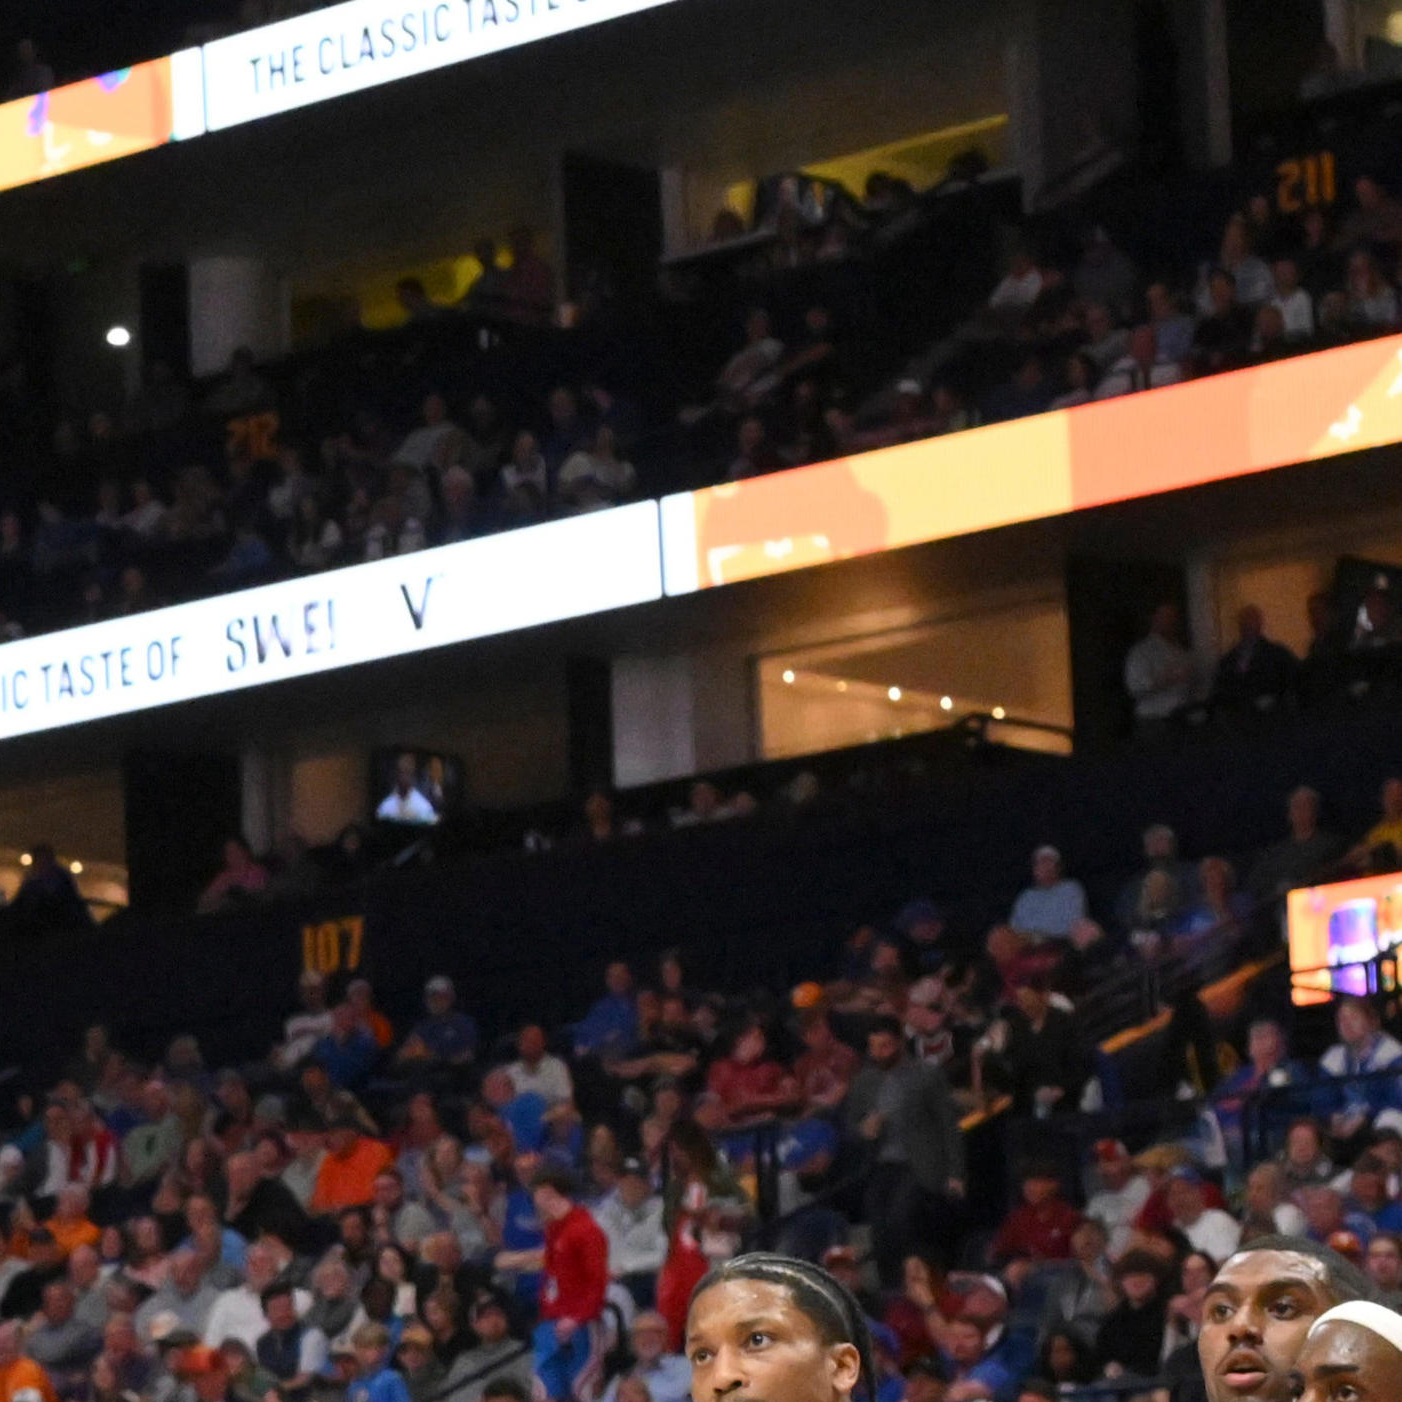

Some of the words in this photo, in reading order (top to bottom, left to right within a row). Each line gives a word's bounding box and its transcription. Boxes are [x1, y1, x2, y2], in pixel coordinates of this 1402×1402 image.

[249, 46, 303, 94] THE
[318, 4, 451, 75] CLASSIC
[465, 0, 561, 33] TAS
[41, 647, 134, 702] TASTE
[147, 637, 184, 682] OF
[302, 916, 363, 974] 107
